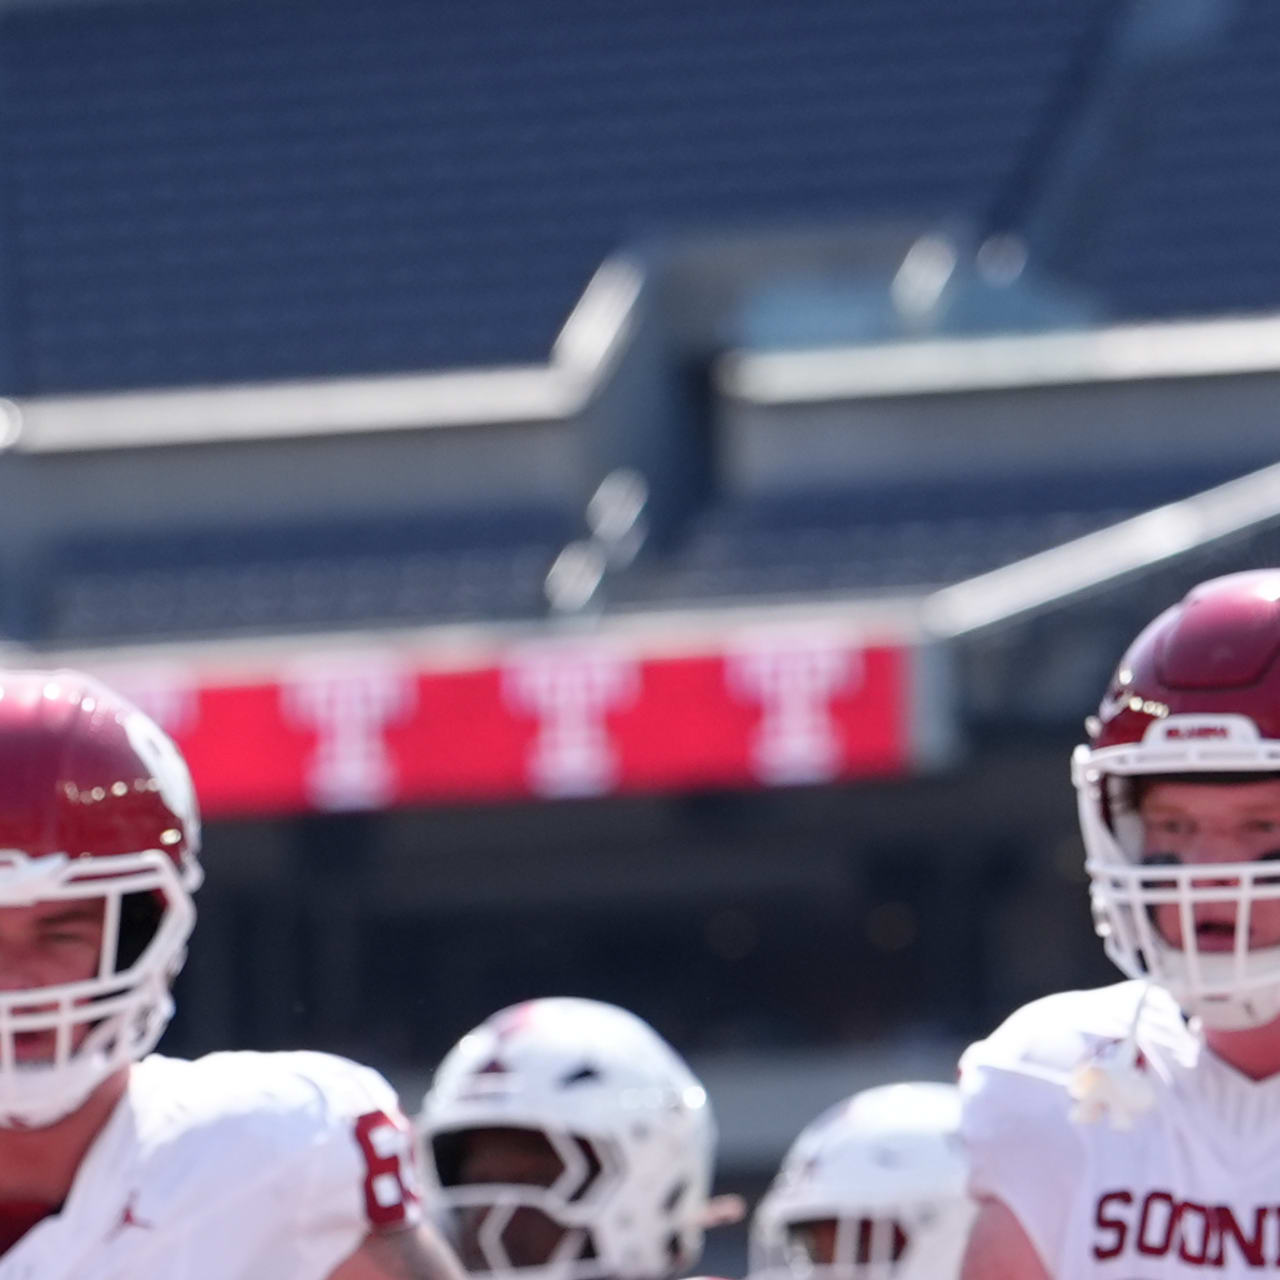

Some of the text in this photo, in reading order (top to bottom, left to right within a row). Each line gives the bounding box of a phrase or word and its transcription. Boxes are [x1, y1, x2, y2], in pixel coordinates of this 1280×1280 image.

[280, 652, 418, 812] T
[501, 640, 637, 798] T
[724, 625, 864, 785] T
[355, 1110, 419, 1225] 6
[1093, 1191, 1280, 1267] SOON
